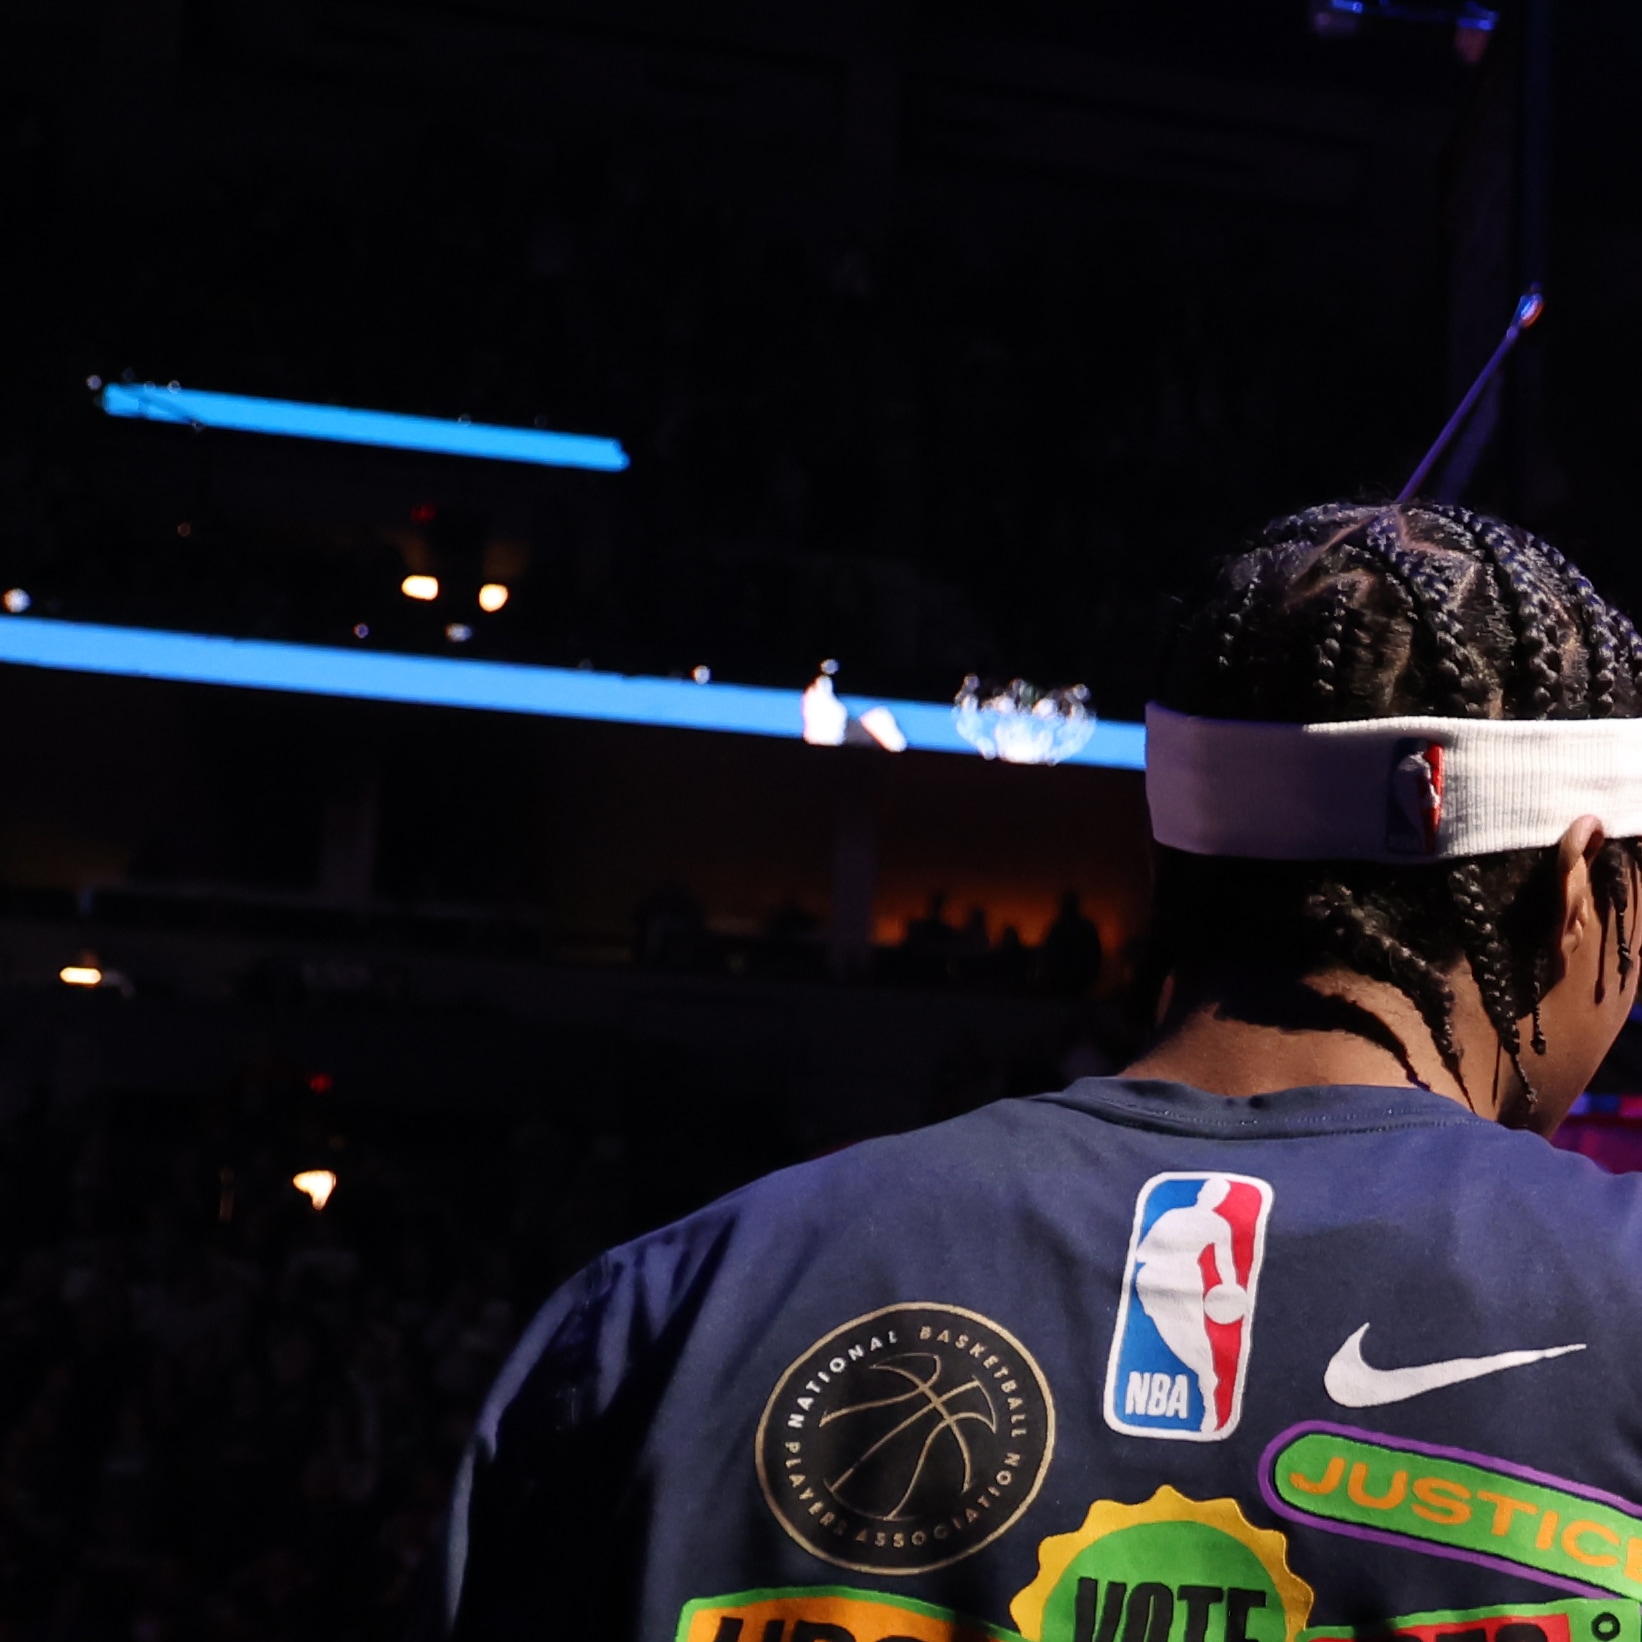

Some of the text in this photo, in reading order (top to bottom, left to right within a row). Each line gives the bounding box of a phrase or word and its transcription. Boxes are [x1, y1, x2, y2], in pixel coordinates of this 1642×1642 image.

[787, 1329, 898, 1429] NATIONAL
[919, 1325, 1028, 1438] BASKETBALL
[1124, 1370, 1191, 1420] NBA
[784, 1441, 846, 1537] PLAYERS
[854, 1452, 1021, 1548] ASSOCIATION
